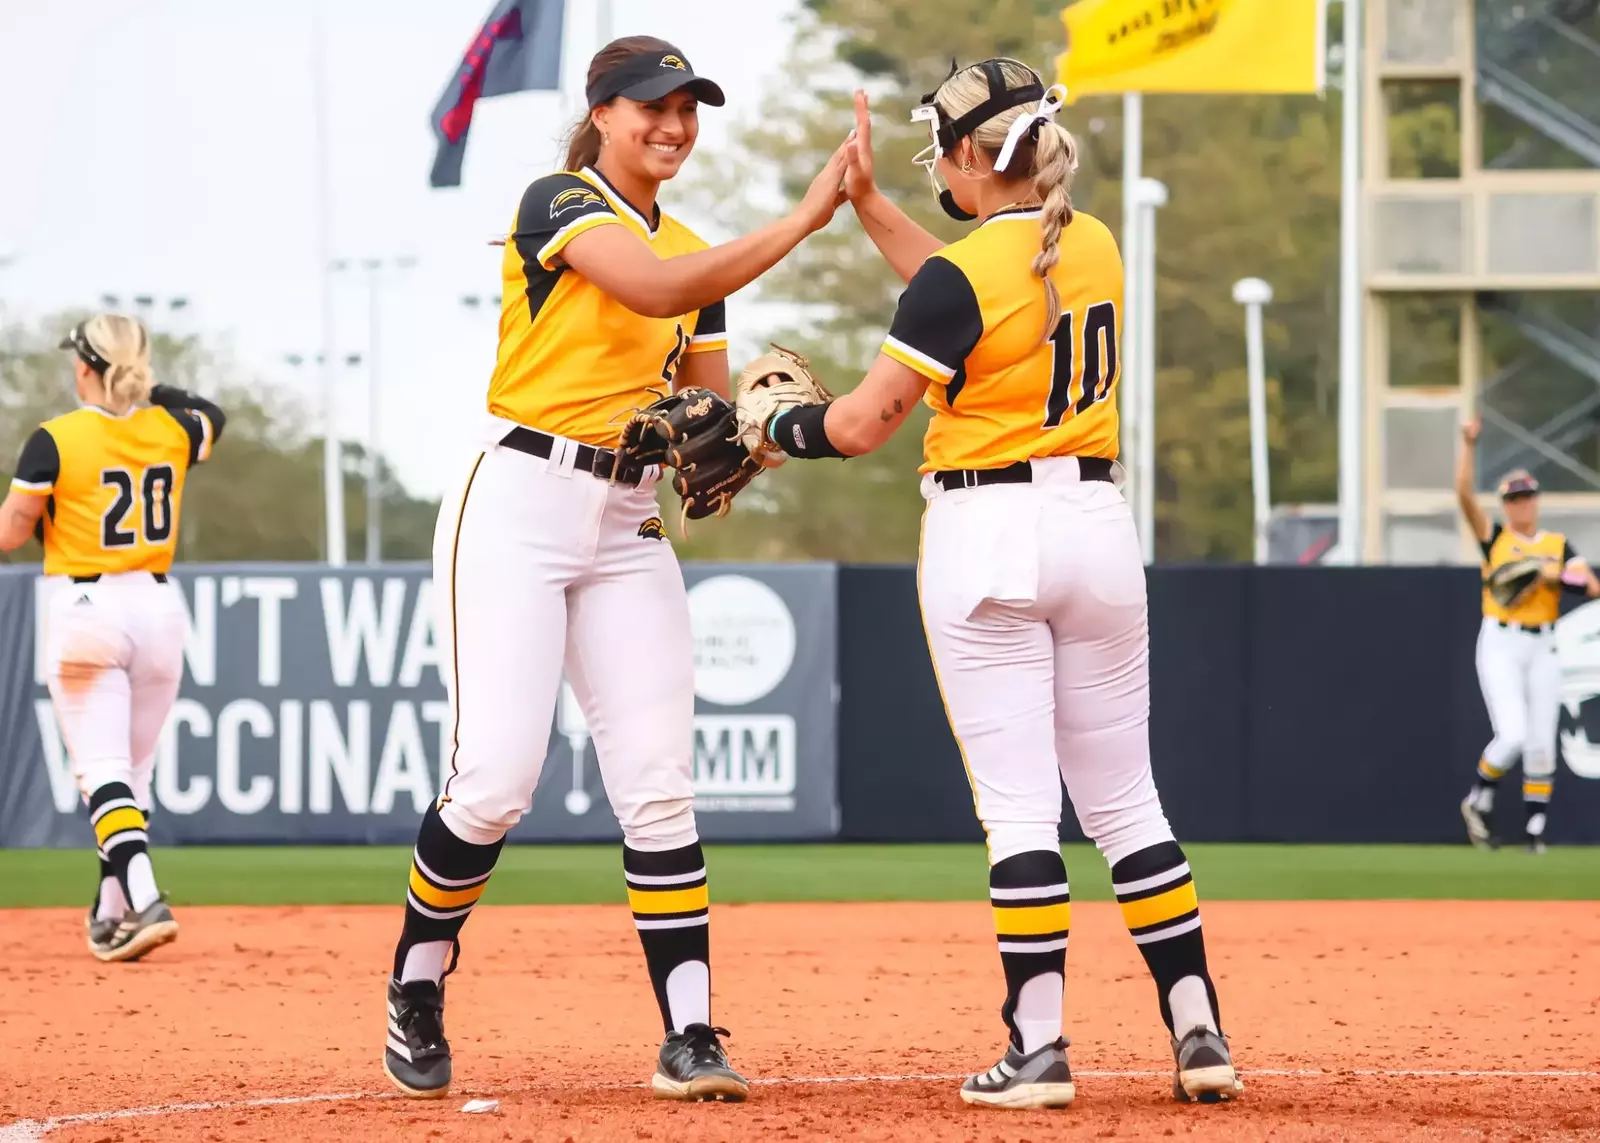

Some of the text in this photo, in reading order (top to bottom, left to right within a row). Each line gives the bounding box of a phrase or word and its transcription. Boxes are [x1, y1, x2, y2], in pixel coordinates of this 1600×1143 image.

[1040, 299, 1118, 430] 10
[100, 462, 176, 550] 20
[319, 576, 447, 688] WA
